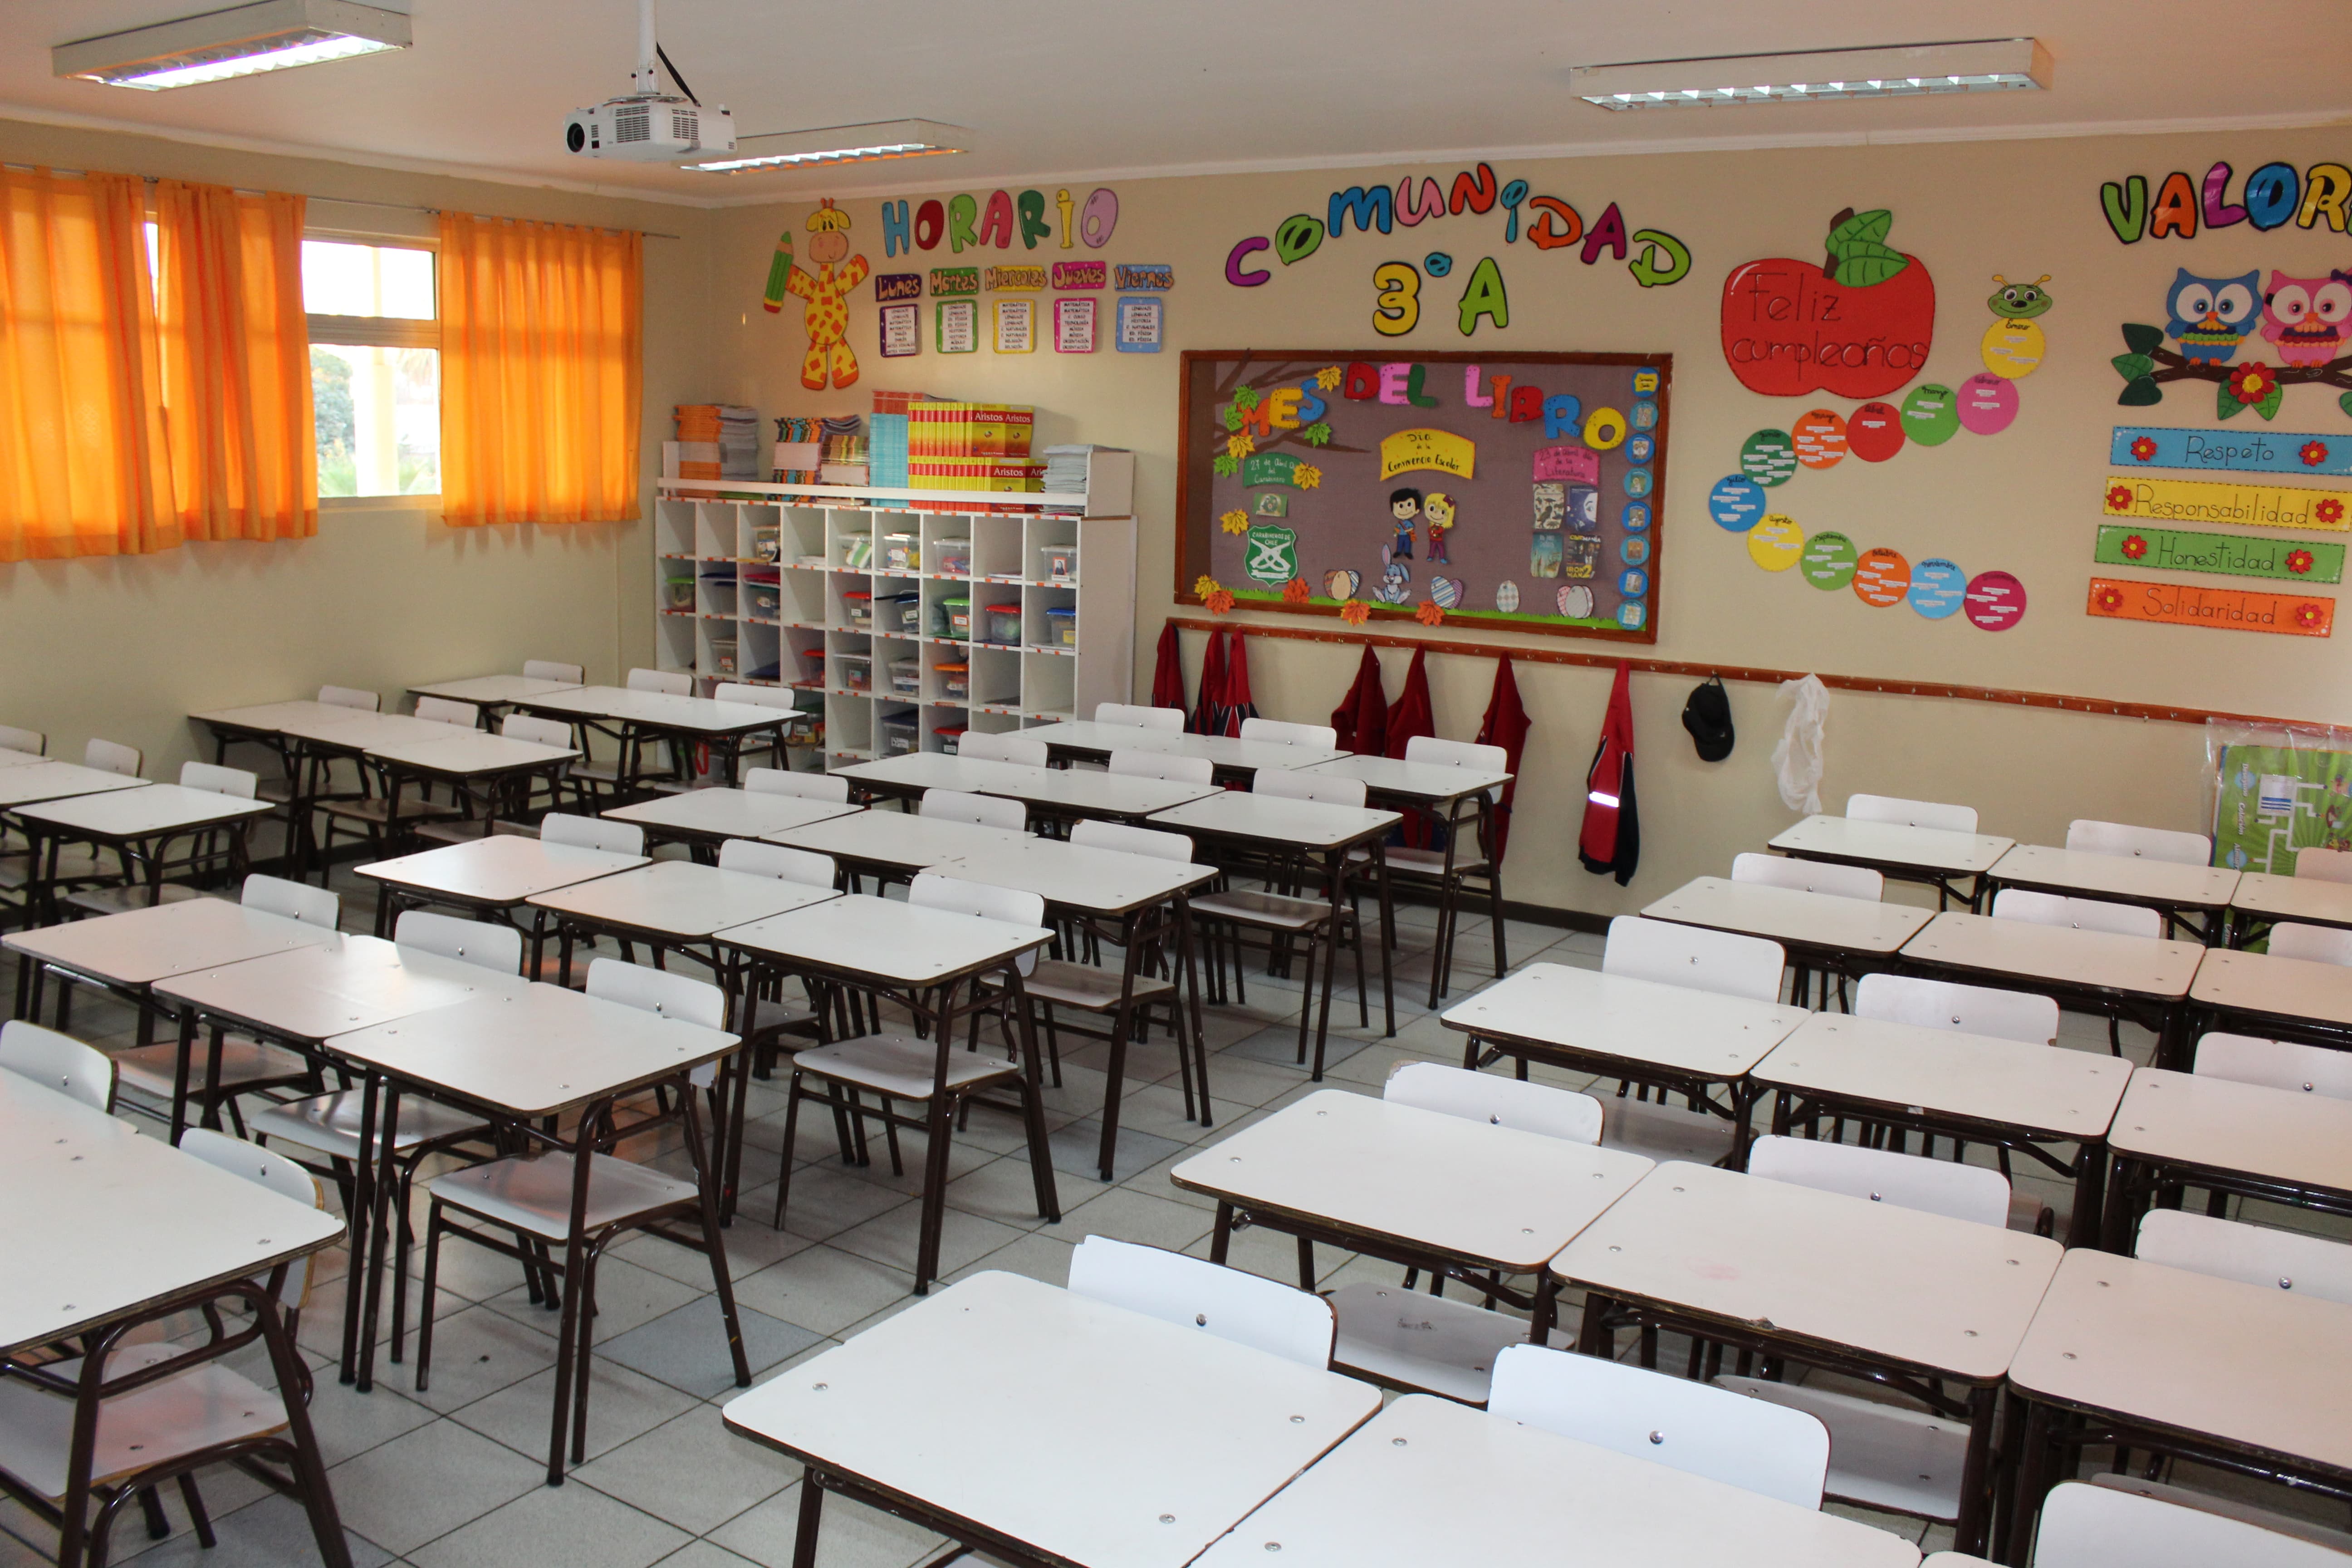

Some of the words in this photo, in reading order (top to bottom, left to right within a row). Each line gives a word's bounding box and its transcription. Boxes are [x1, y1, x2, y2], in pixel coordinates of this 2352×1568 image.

[2100, 161, 2352, 245] VALOR
[882, 188, 1118, 258] HORARIO
[1225, 162, 1691, 289] COMUNIDAD
[878, 277, 920, 300] Lunes
[931, 271, 979, 294] Martes
[1053, 264, 1106, 288] Jueves
[1114, 266, 1174, 289] Viernes
[1458, 256, 1509, 336] A
[1747, 273, 1842, 323] Feliz
[2006, 318, 2030, 330] Enero
[1732, 330, 1930, 382] cumpleaños
[975, 412, 1003, 421] Aristos
[1005, 413, 1031, 423] Aristos
[1237, 378, 1325, 436] MES
[1344, 363, 1436, 407] DEL
[1465, 365, 1625, 450] LIBRO
[1436, 454, 1460, 471] Escolar
[2184, 436, 2274, 466] Respeto
[994, 467, 1024, 476] Aristos
[2133, 484, 2309, 525] Responsabilidad
[2157, 535, 2275, 572] Honestidad
[1583, 565, 1592, 578] 2
[2143, 588, 2275, 626] Solidaridad
